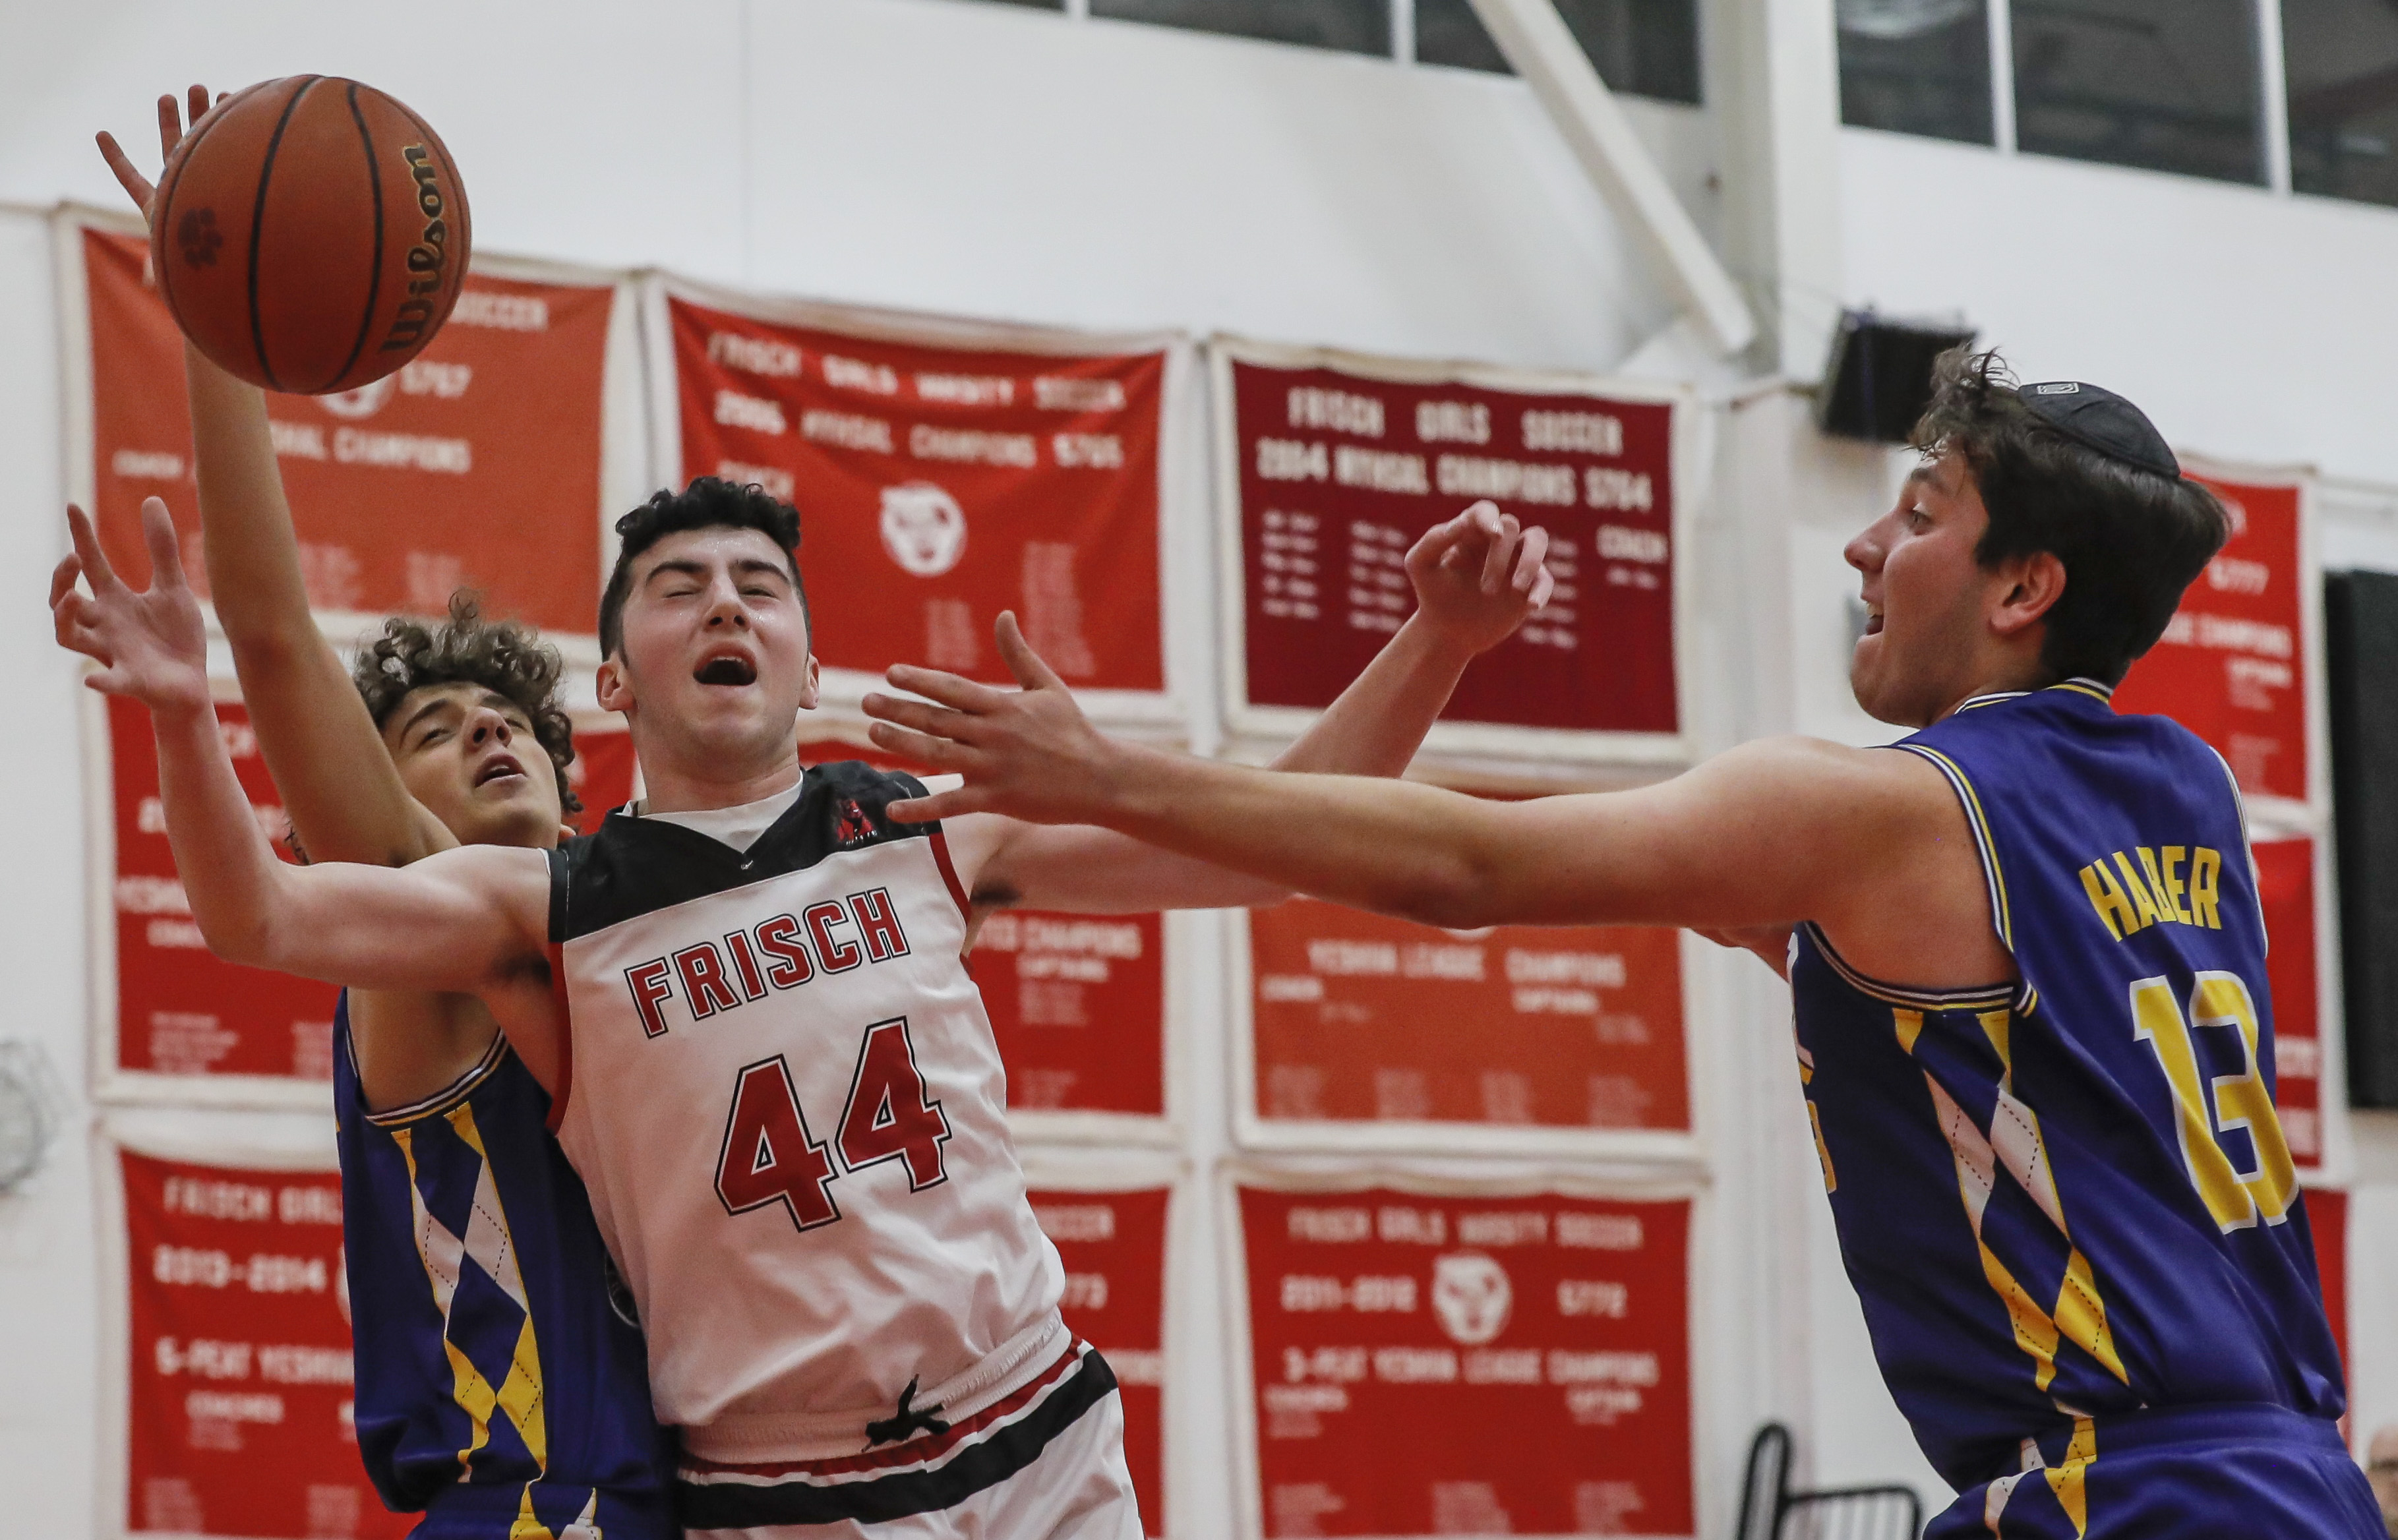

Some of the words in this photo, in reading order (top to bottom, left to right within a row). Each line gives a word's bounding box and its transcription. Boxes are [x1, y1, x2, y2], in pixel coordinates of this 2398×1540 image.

[376, 142, 446, 355] Wilson
[334, 429, 471, 473] CHAMPIONS
[1288, 388, 1384, 436] FRISCH
[1416, 402, 1490, 444] GIRLS
[1522, 411, 1622, 455] SOCCER
[1257, 438, 1329, 480] 2004
[1437, 456, 1575, 507] CHAMPIONS
[2079, 844, 2222, 943] HABER
[624, 887, 911, 1039] FRISCH
[713, 1015, 953, 1233] 44
[2129, 970, 2299, 1234] 13
[164, 1178, 271, 1220] FRISCH
[154, 1245, 326, 1292] 2013-2014
[1282, 1276, 1416, 1311] 2011-2012
